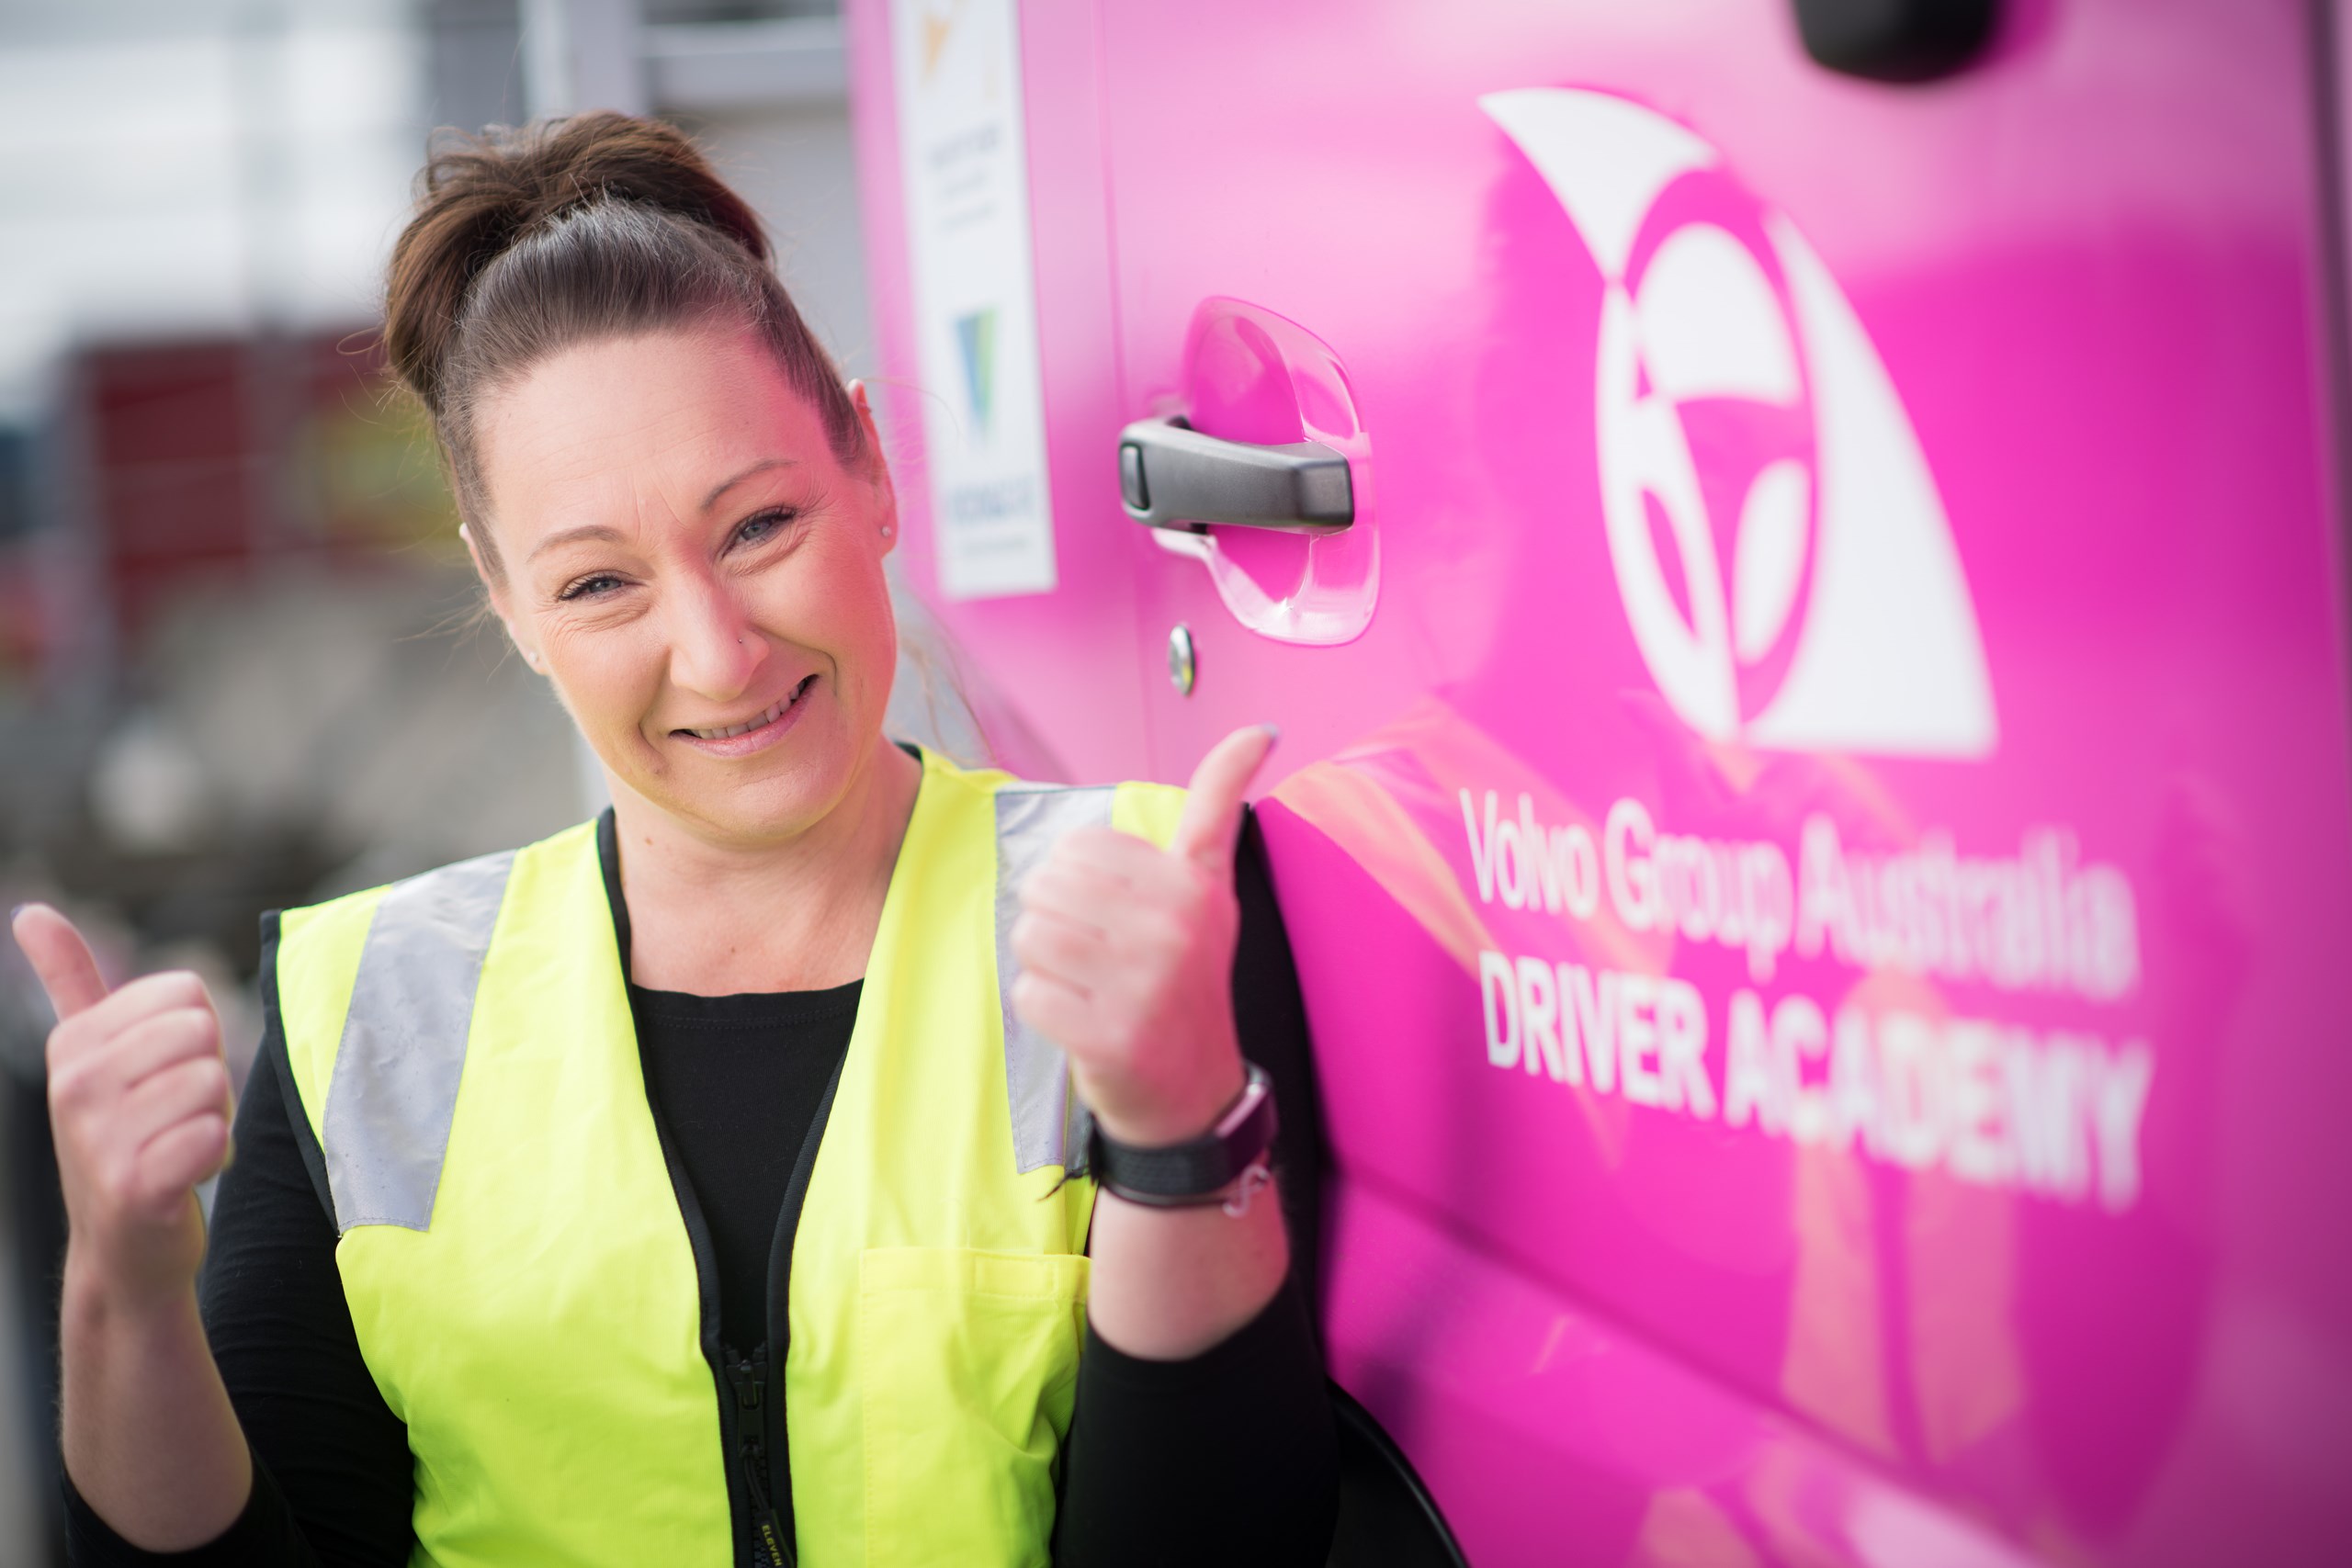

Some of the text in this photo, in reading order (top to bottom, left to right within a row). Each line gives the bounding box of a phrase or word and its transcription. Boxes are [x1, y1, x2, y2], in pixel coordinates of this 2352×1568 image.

[1459, 788, 2139, 1001] Volvo Group Australia
[1479, 950, 2153, 1214] DRIVER ACADEMY
